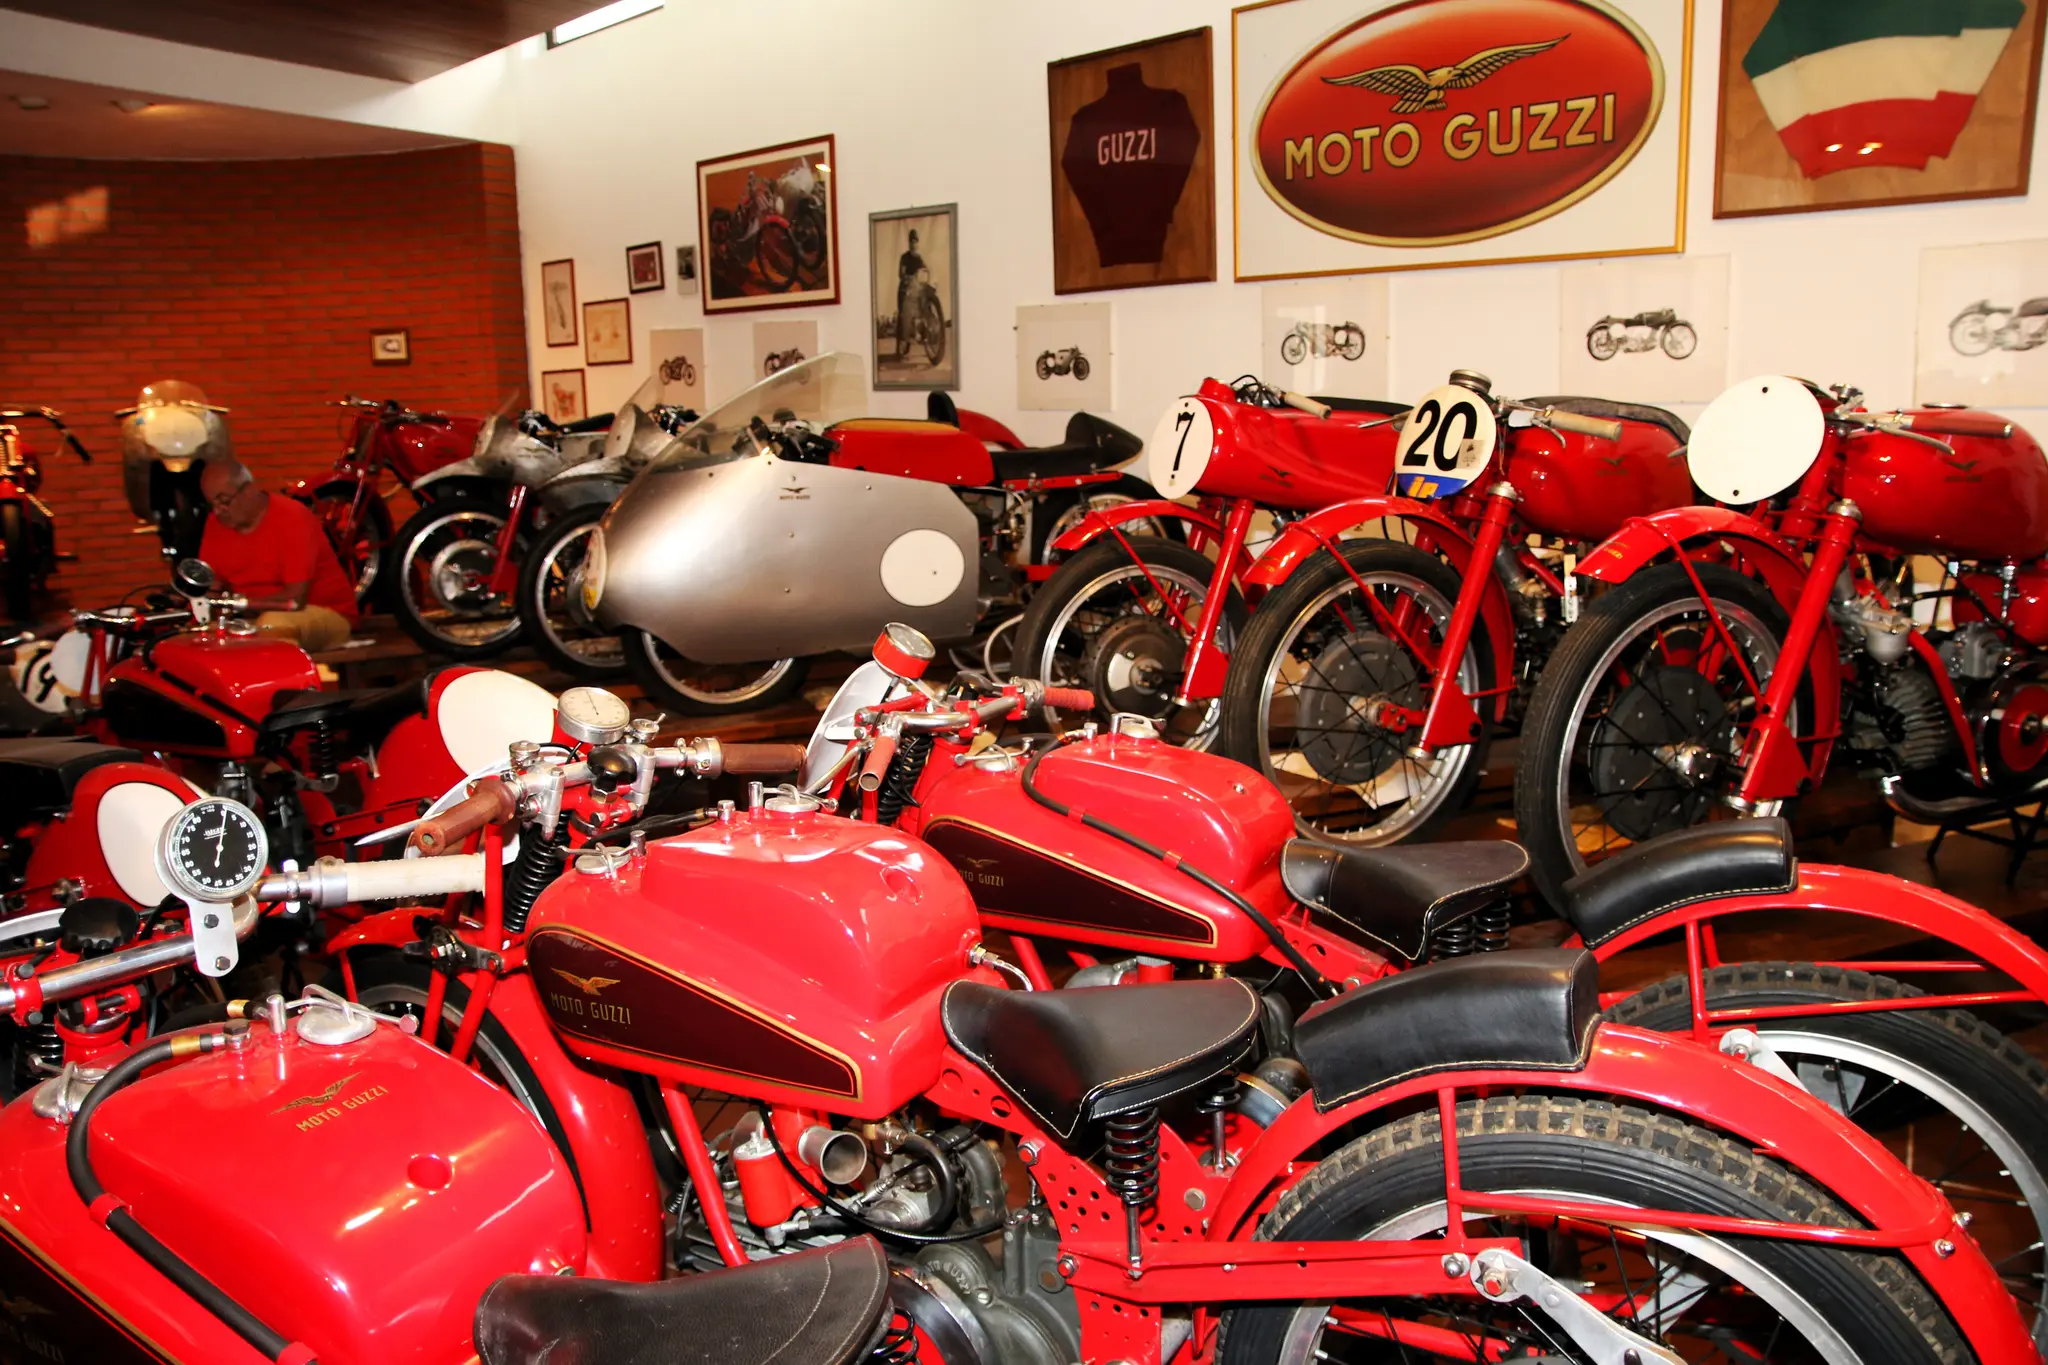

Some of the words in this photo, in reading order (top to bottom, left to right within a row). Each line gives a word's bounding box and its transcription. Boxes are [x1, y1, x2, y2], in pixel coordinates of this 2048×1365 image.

[1097, 127, 1156, 166] GUZZI
[1284, 121, 1421, 181] MOTO
[1443, 92, 1617, 161] GUZZI
[1175, 411, 1195, 471] 7
[1402, 399, 1477, 471] 20
[958, 869, 974, 882] TO
[978, 873, 1004, 887] GUZZI
[551, 992, 584, 1016] MOTO
[590, 1002, 631, 1025] GUZZI
[295, 1107, 342, 1132] MOTO
[342, 1085, 388, 1109] GUZZI
